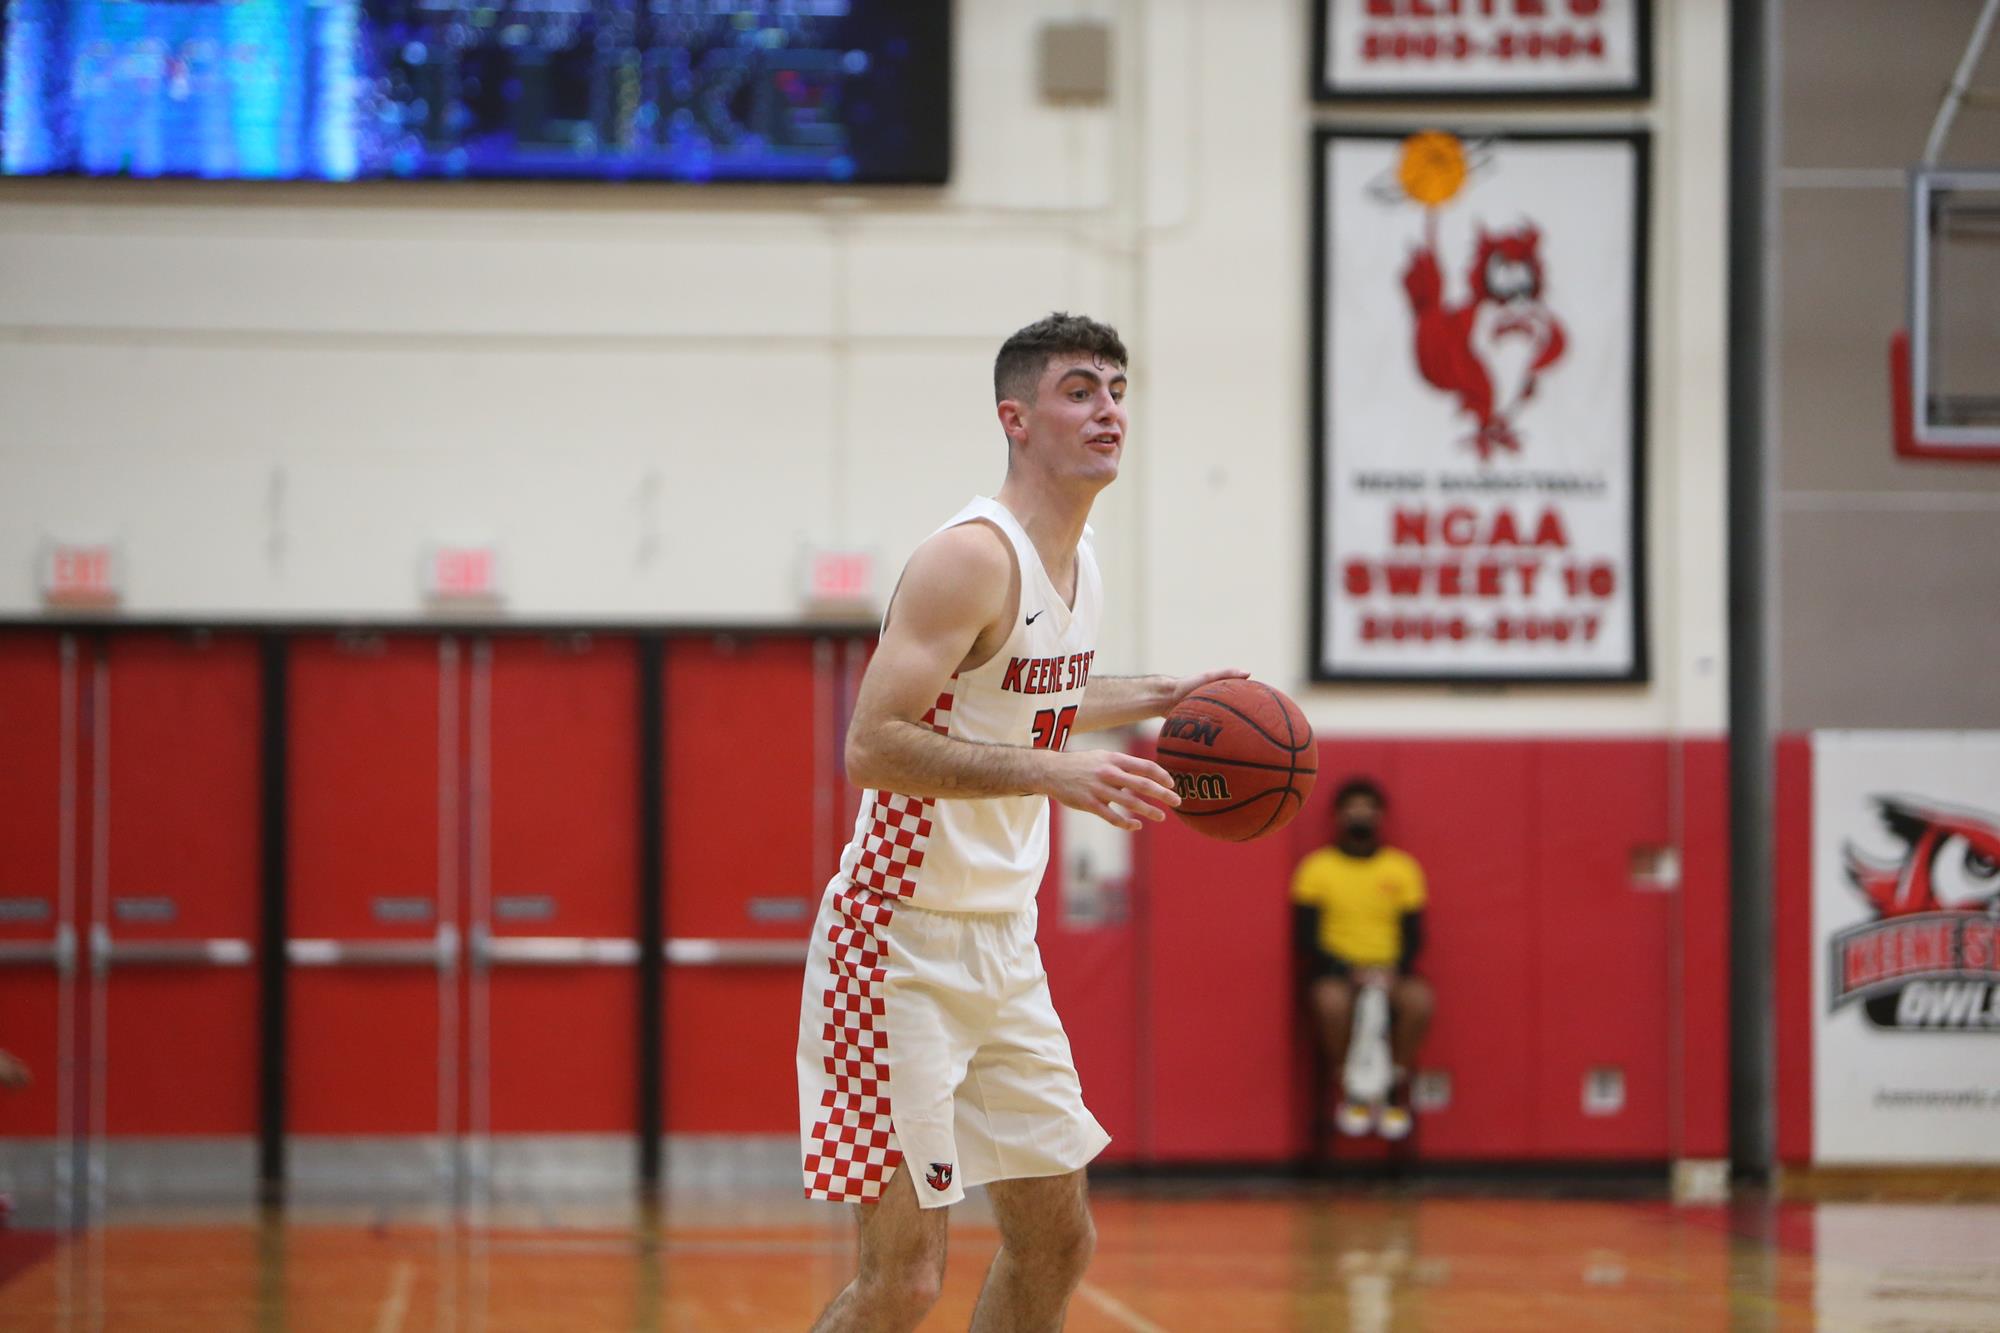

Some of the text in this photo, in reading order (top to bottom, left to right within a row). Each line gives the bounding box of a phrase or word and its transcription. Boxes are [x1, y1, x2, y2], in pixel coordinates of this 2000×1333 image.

[1393, 507, 1567, 547] NCAA
[1344, 560, 1541, 598] SWEET
[1001, 656, 1066, 695] KEENE
